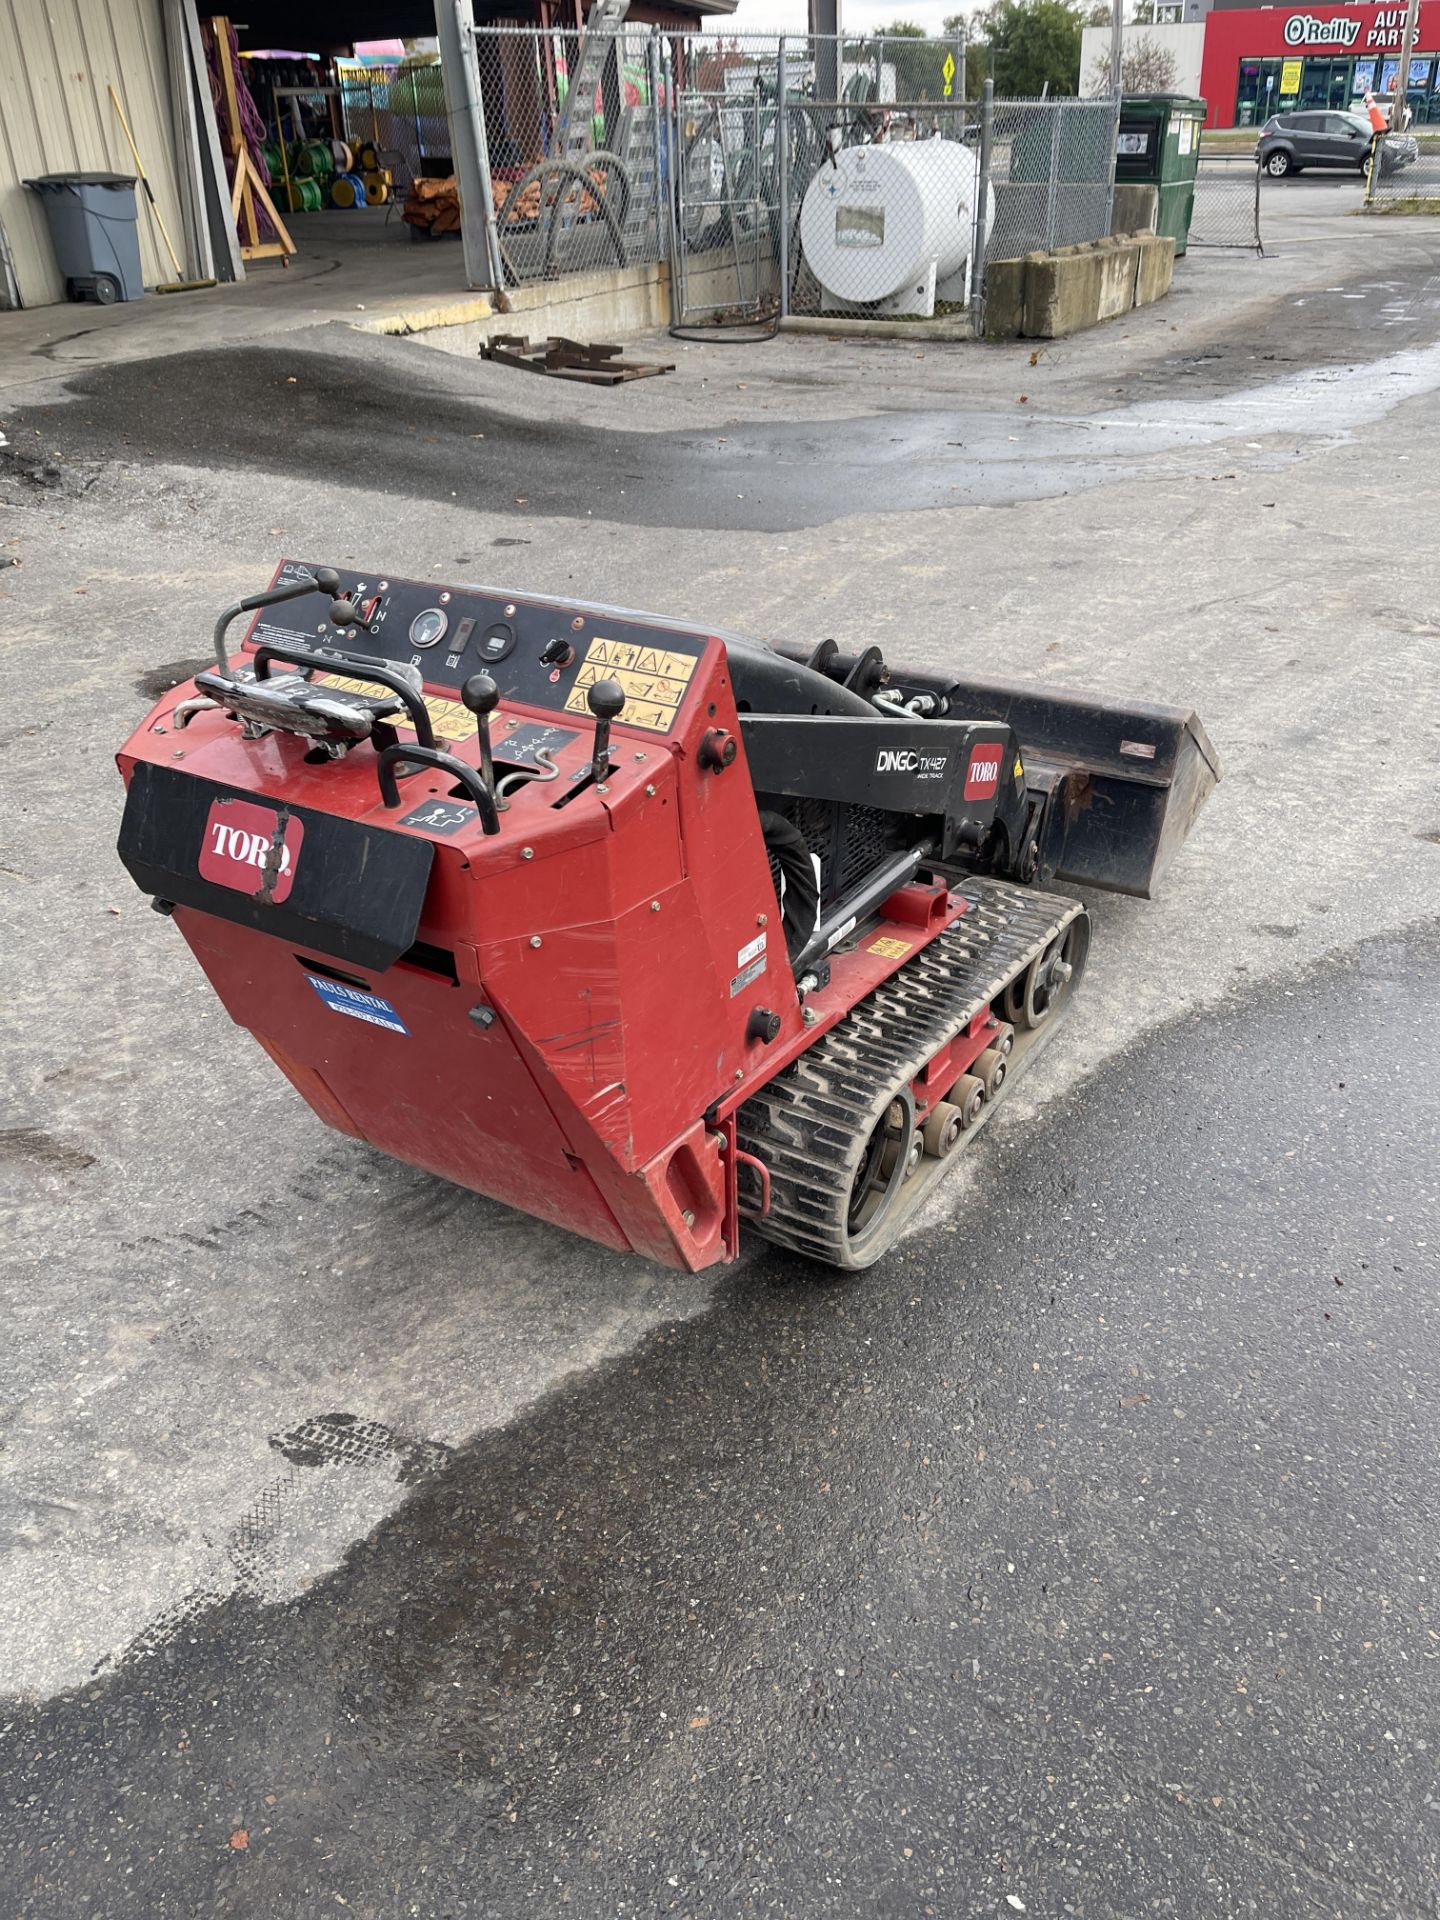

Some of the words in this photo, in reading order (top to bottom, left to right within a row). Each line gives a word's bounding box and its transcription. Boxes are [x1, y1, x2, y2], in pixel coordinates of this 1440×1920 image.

[1285, 14, 1361, 46] O'Reilly
[970, 761, 998, 783] TORO
[344, 988, 394, 1013] RENTAL
